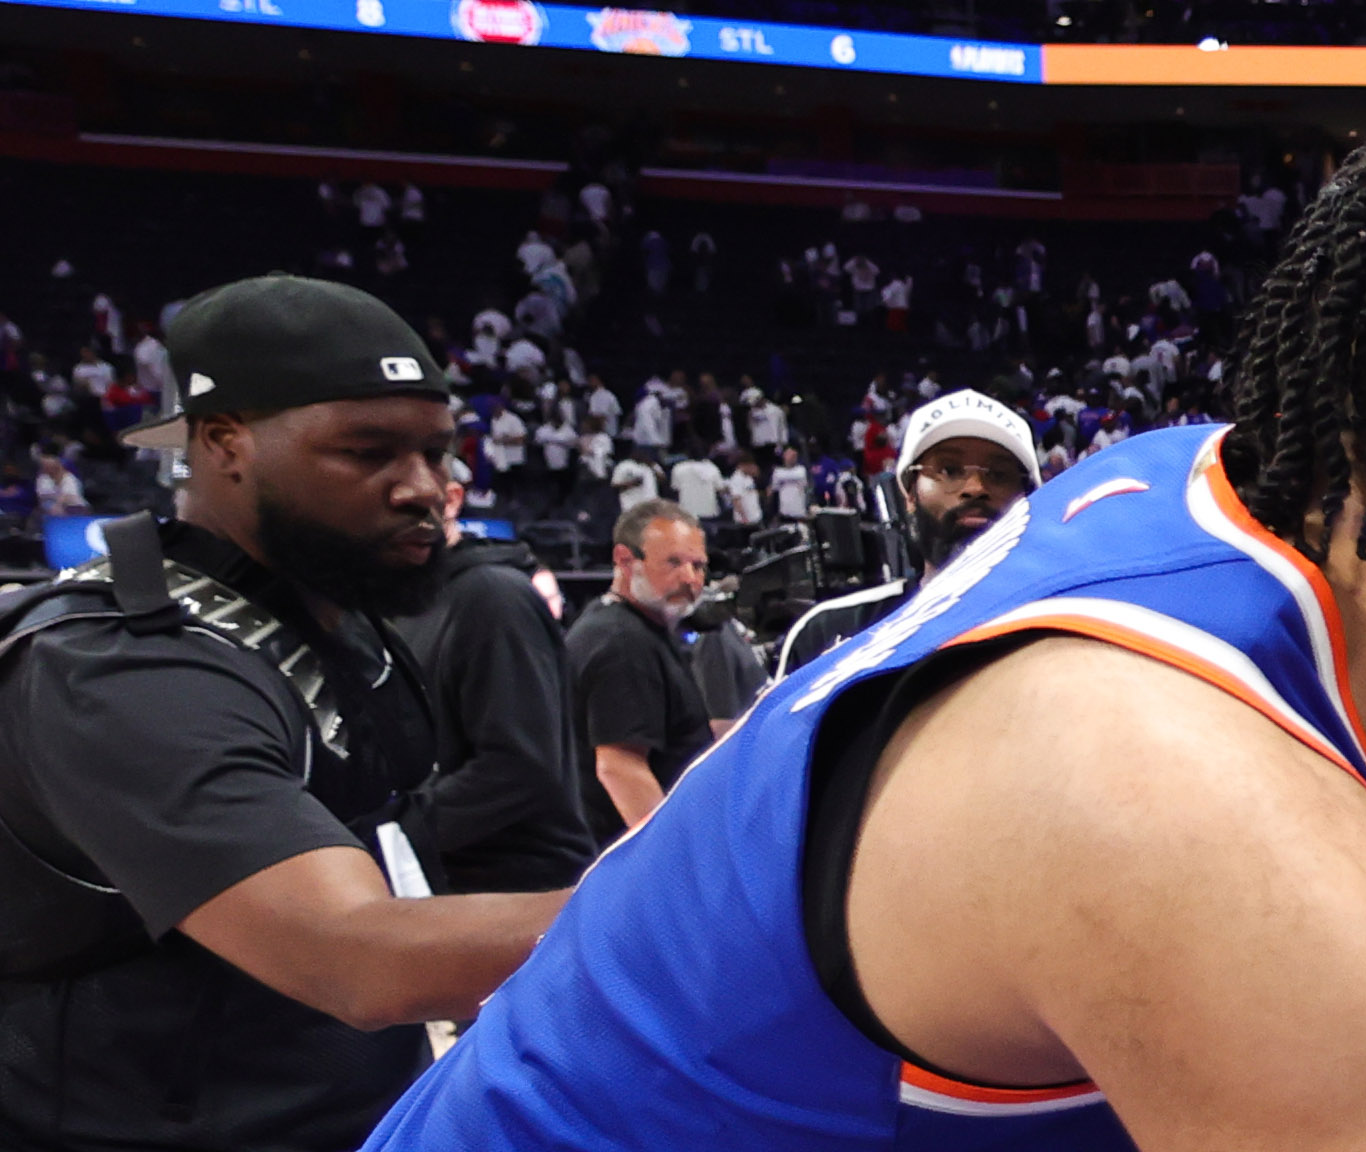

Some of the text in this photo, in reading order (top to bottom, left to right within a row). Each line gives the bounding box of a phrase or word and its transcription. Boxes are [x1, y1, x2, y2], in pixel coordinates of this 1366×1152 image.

[356, 0, 385, 27] 8
[719, 27, 855, 64] STL 6
